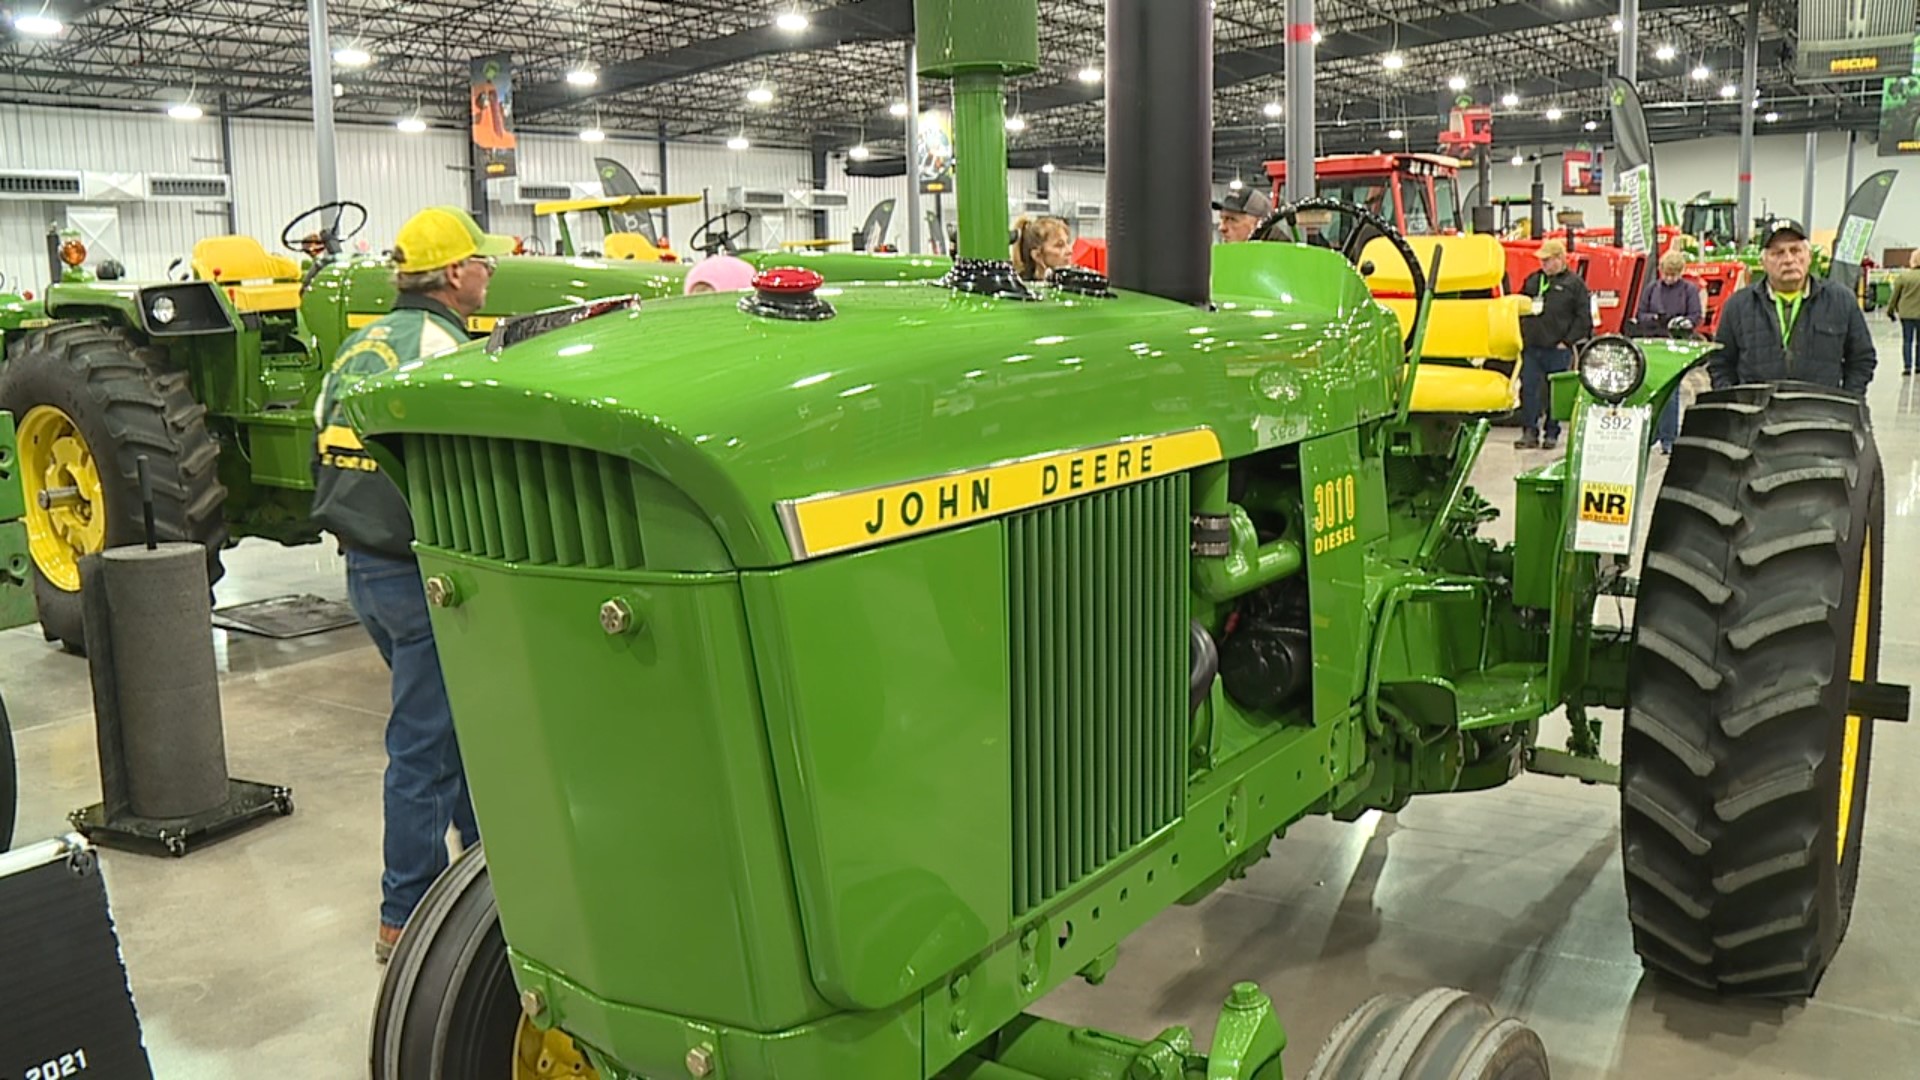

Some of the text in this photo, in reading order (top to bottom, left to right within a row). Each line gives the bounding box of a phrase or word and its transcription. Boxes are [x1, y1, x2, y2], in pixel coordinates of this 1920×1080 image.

[1830, 57, 1877, 73] MECUM
[1600, 416, 1632, 430] S92
[865, 445, 1153, 534] JOHN DEERE
[1313, 474, 1355, 533] 3010
[1584, 491, 1626, 515] NR
[1314, 526, 1356, 555] DIESEL
[25, 1048, 87, 1080] 2021
